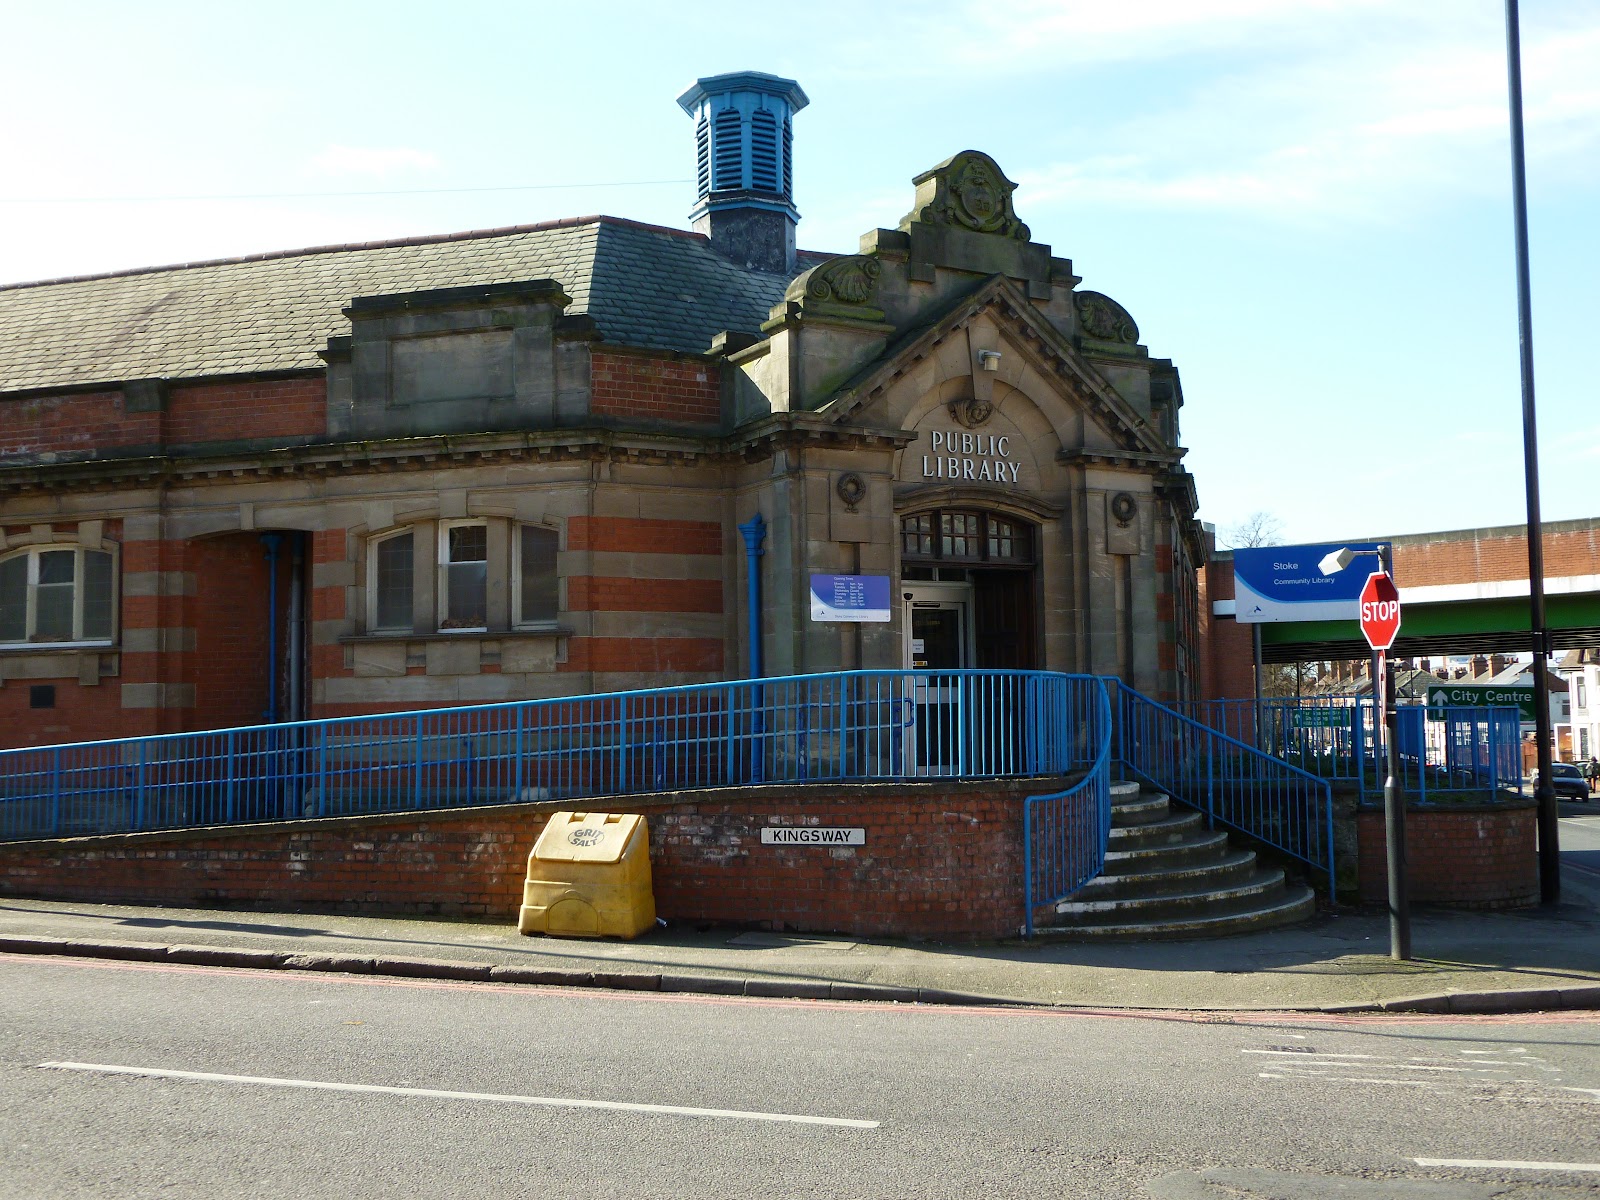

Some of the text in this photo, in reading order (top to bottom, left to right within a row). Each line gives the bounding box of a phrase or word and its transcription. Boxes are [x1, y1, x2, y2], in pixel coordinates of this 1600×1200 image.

[931, 430, 1010, 458] PUBLIC
[922, 455, 1021, 483] LIBRARY
[1273, 562, 1298, 571] Stoke
[1273, 577, 1335, 586] Community Library
[1362, 600, 1398, 622] STOP
[1451, 690, 1532, 703] City Centre
[574, 828, 604, 839] GRIT
[773, 830, 851, 842] KINGSWAY
[570, 838, 597, 847] SALT
